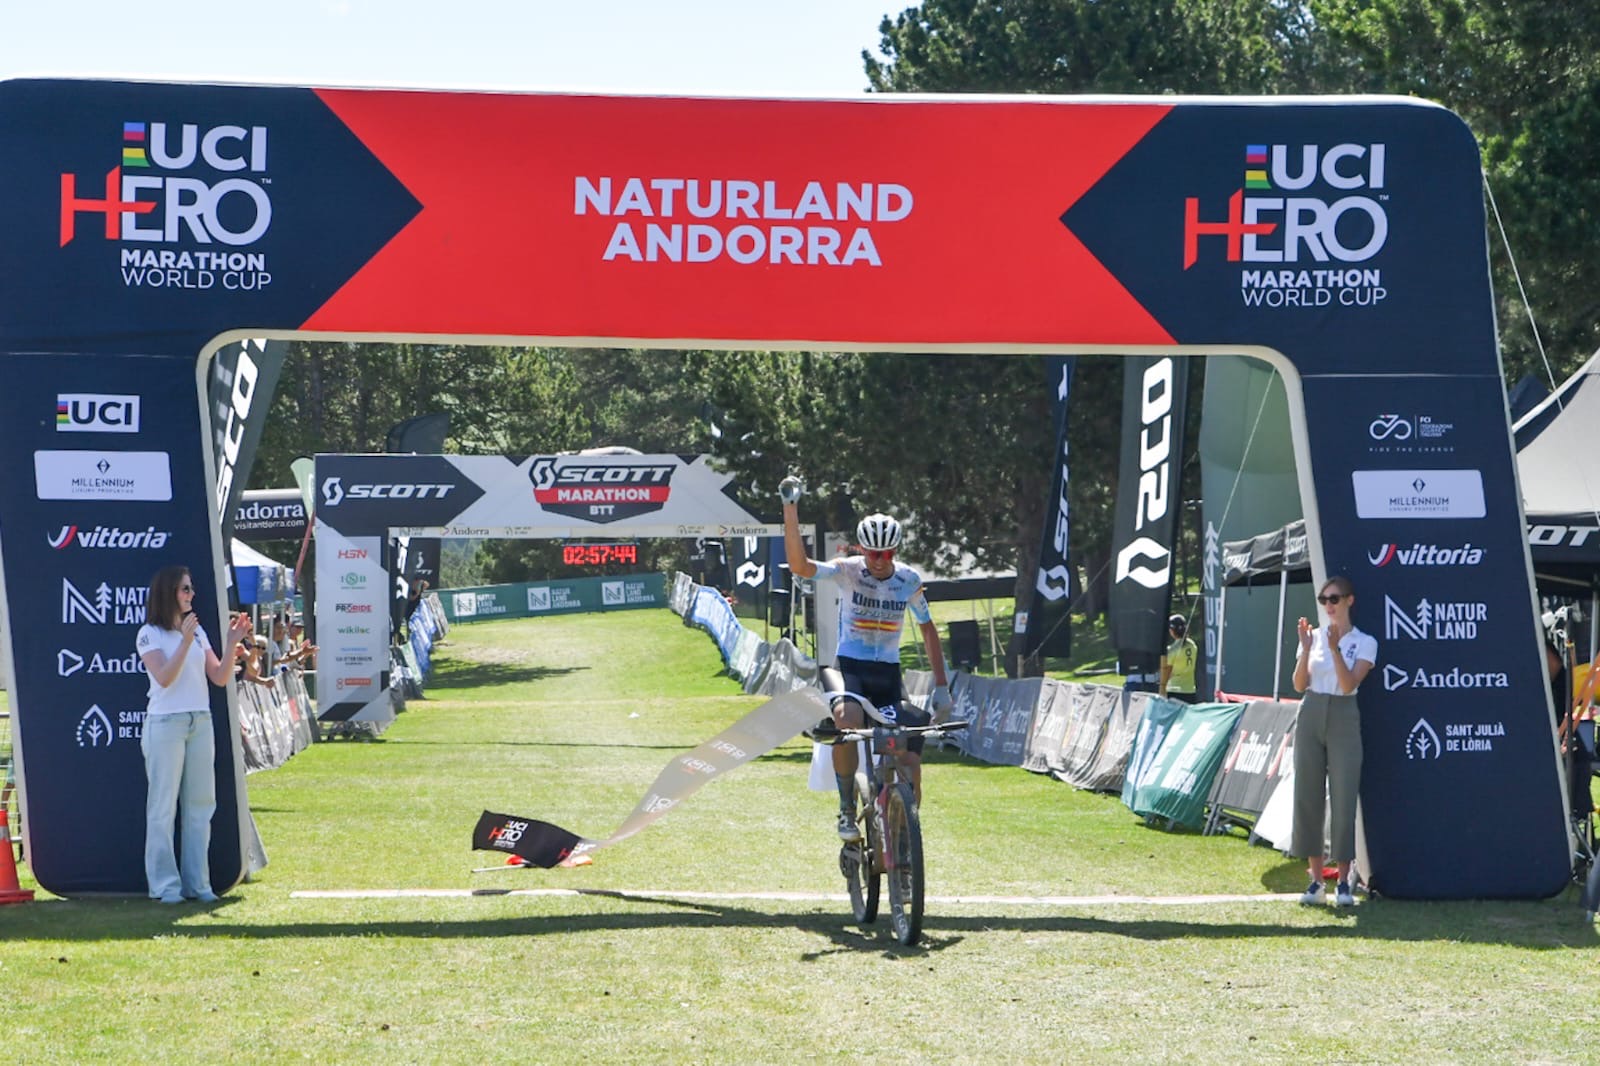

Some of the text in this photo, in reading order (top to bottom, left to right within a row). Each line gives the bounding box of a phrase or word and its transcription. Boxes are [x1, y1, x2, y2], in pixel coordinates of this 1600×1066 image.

[150, 122, 267, 172] UCI
[1271, 143, 1386, 190] UCI
[60, 165, 272, 248] HERO
[573, 176, 914, 222] NATURLAND
[1183, 187, 1389, 271] HERO
[602, 222, 883, 266] ANDORRA
[120, 249, 265, 271] MARATHON
[120, 267, 272, 291] WORLD CUP
[1241, 269, 1380, 288] MARATHON
[1241, 287, 1388, 307] WORLD CUP
[71, 401, 133, 425] UCI
[216, 338, 267, 525] SCO
[71, 478, 135, 488] MILLENNIUM
[557, 467, 672, 482] SCOTT
[346, 484, 456, 498] SCOTT
[557, 487, 650, 501] MARATHON
[235, 501, 304, 521] ndorra
[589, 504, 615, 515] BTT
[1389, 497, 1449, 506] MILLENNIUM
[77, 526, 168, 549] vittoria
[450, 526, 490, 536] Andorra
[729, 526, 768, 535] Andorra
[563, 546, 637, 565] 02:57:44
[1398, 543, 1483, 565] vittoria
[1435, 603, 1488, 621] NATUR
[338, 625, 370, 634] wikiloc
[1435, 621, 1478, 640] LAND
[1411, 667, 1509, 688] Andorra
[118, 726, 133, 738] DE
[1446, 721, 1506, 737] SANT JULIÀ
[886, 737, 896, 749] 3
[1446, 736, 1492, 752] DE LÒRIA
